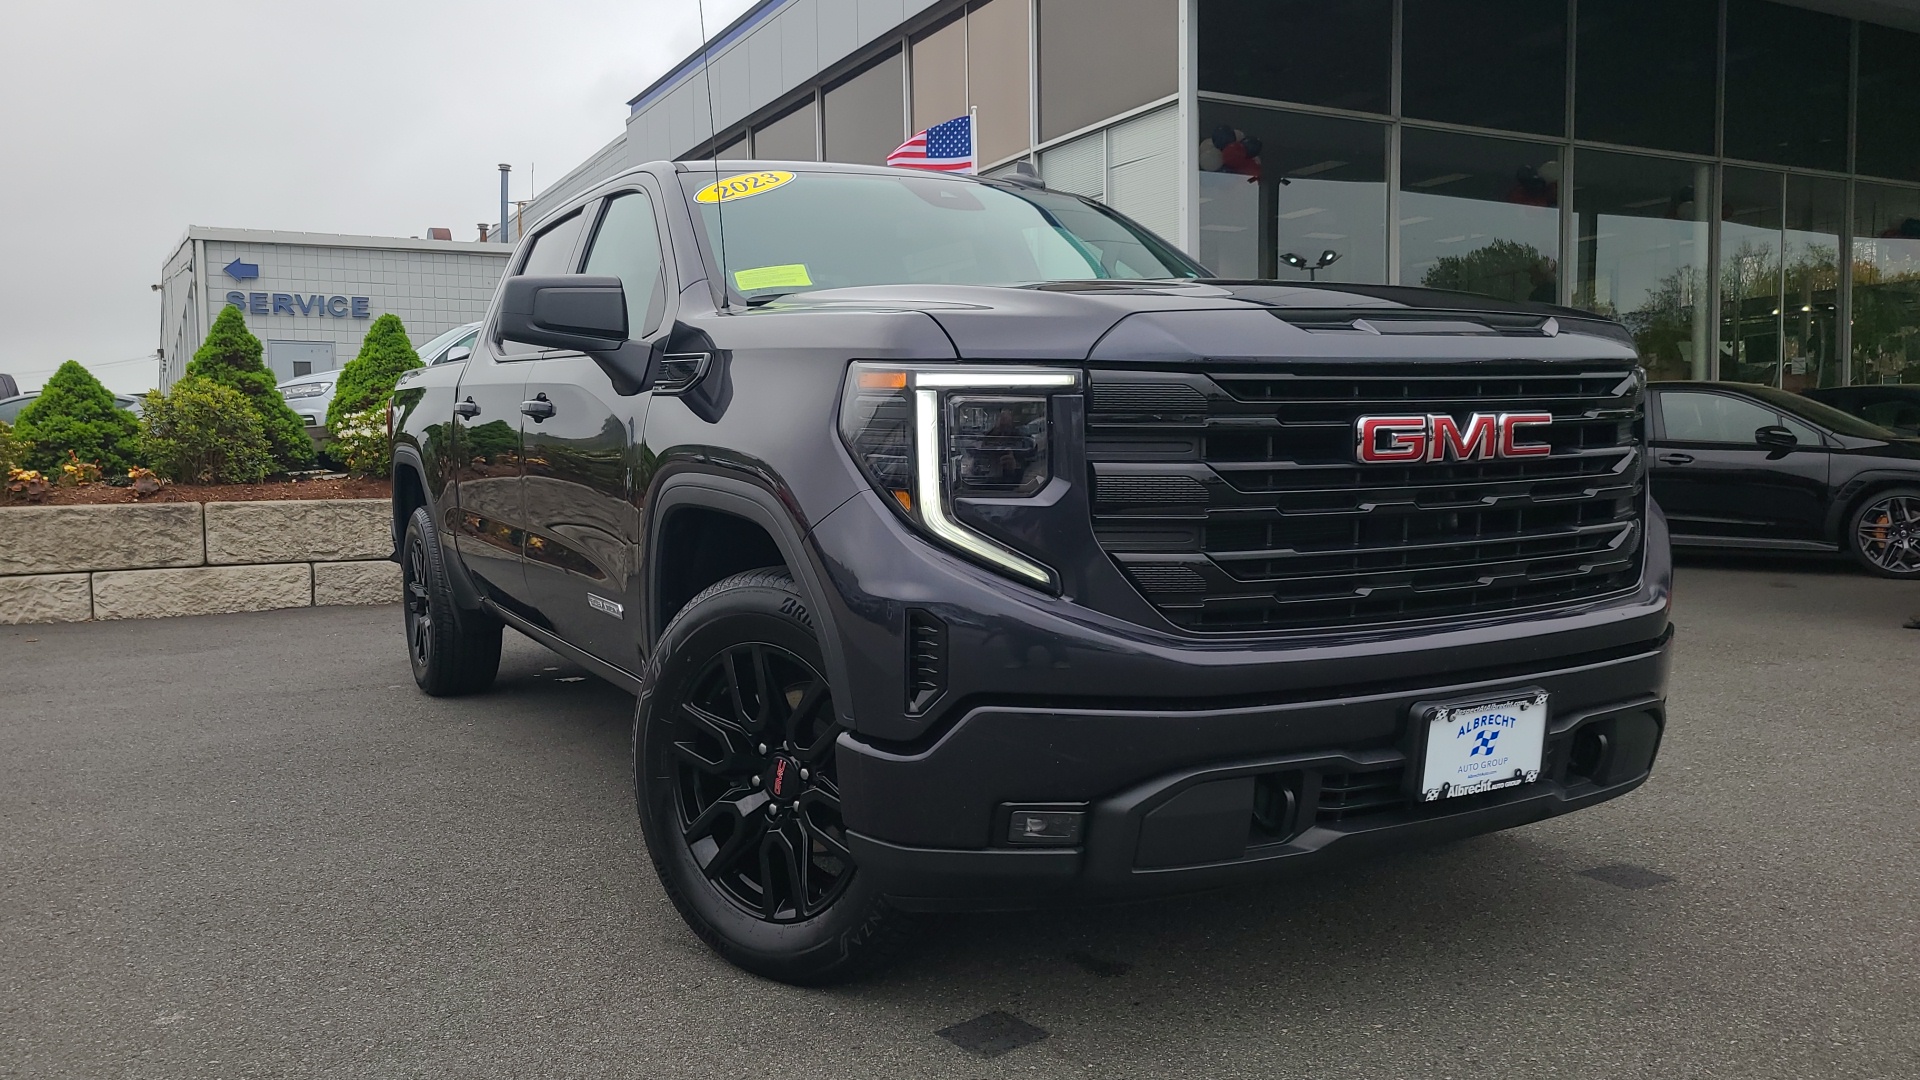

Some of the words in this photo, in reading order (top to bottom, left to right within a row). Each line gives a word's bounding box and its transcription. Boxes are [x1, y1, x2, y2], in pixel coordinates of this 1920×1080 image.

[713, 173, 780, 199] 2023
[226, 291, 370, 318] SERVICE
[1356, 412, 1552, 463] GMC
[1457, 714, 1516, 739] ALBRECHT
[774, 759, 787, 795] GMC
[1457, 762, 1479, 773] AUTO
[1480, 757, 1509, 769] GROUP
[1447, 779, 1492, 798] Albrecht
